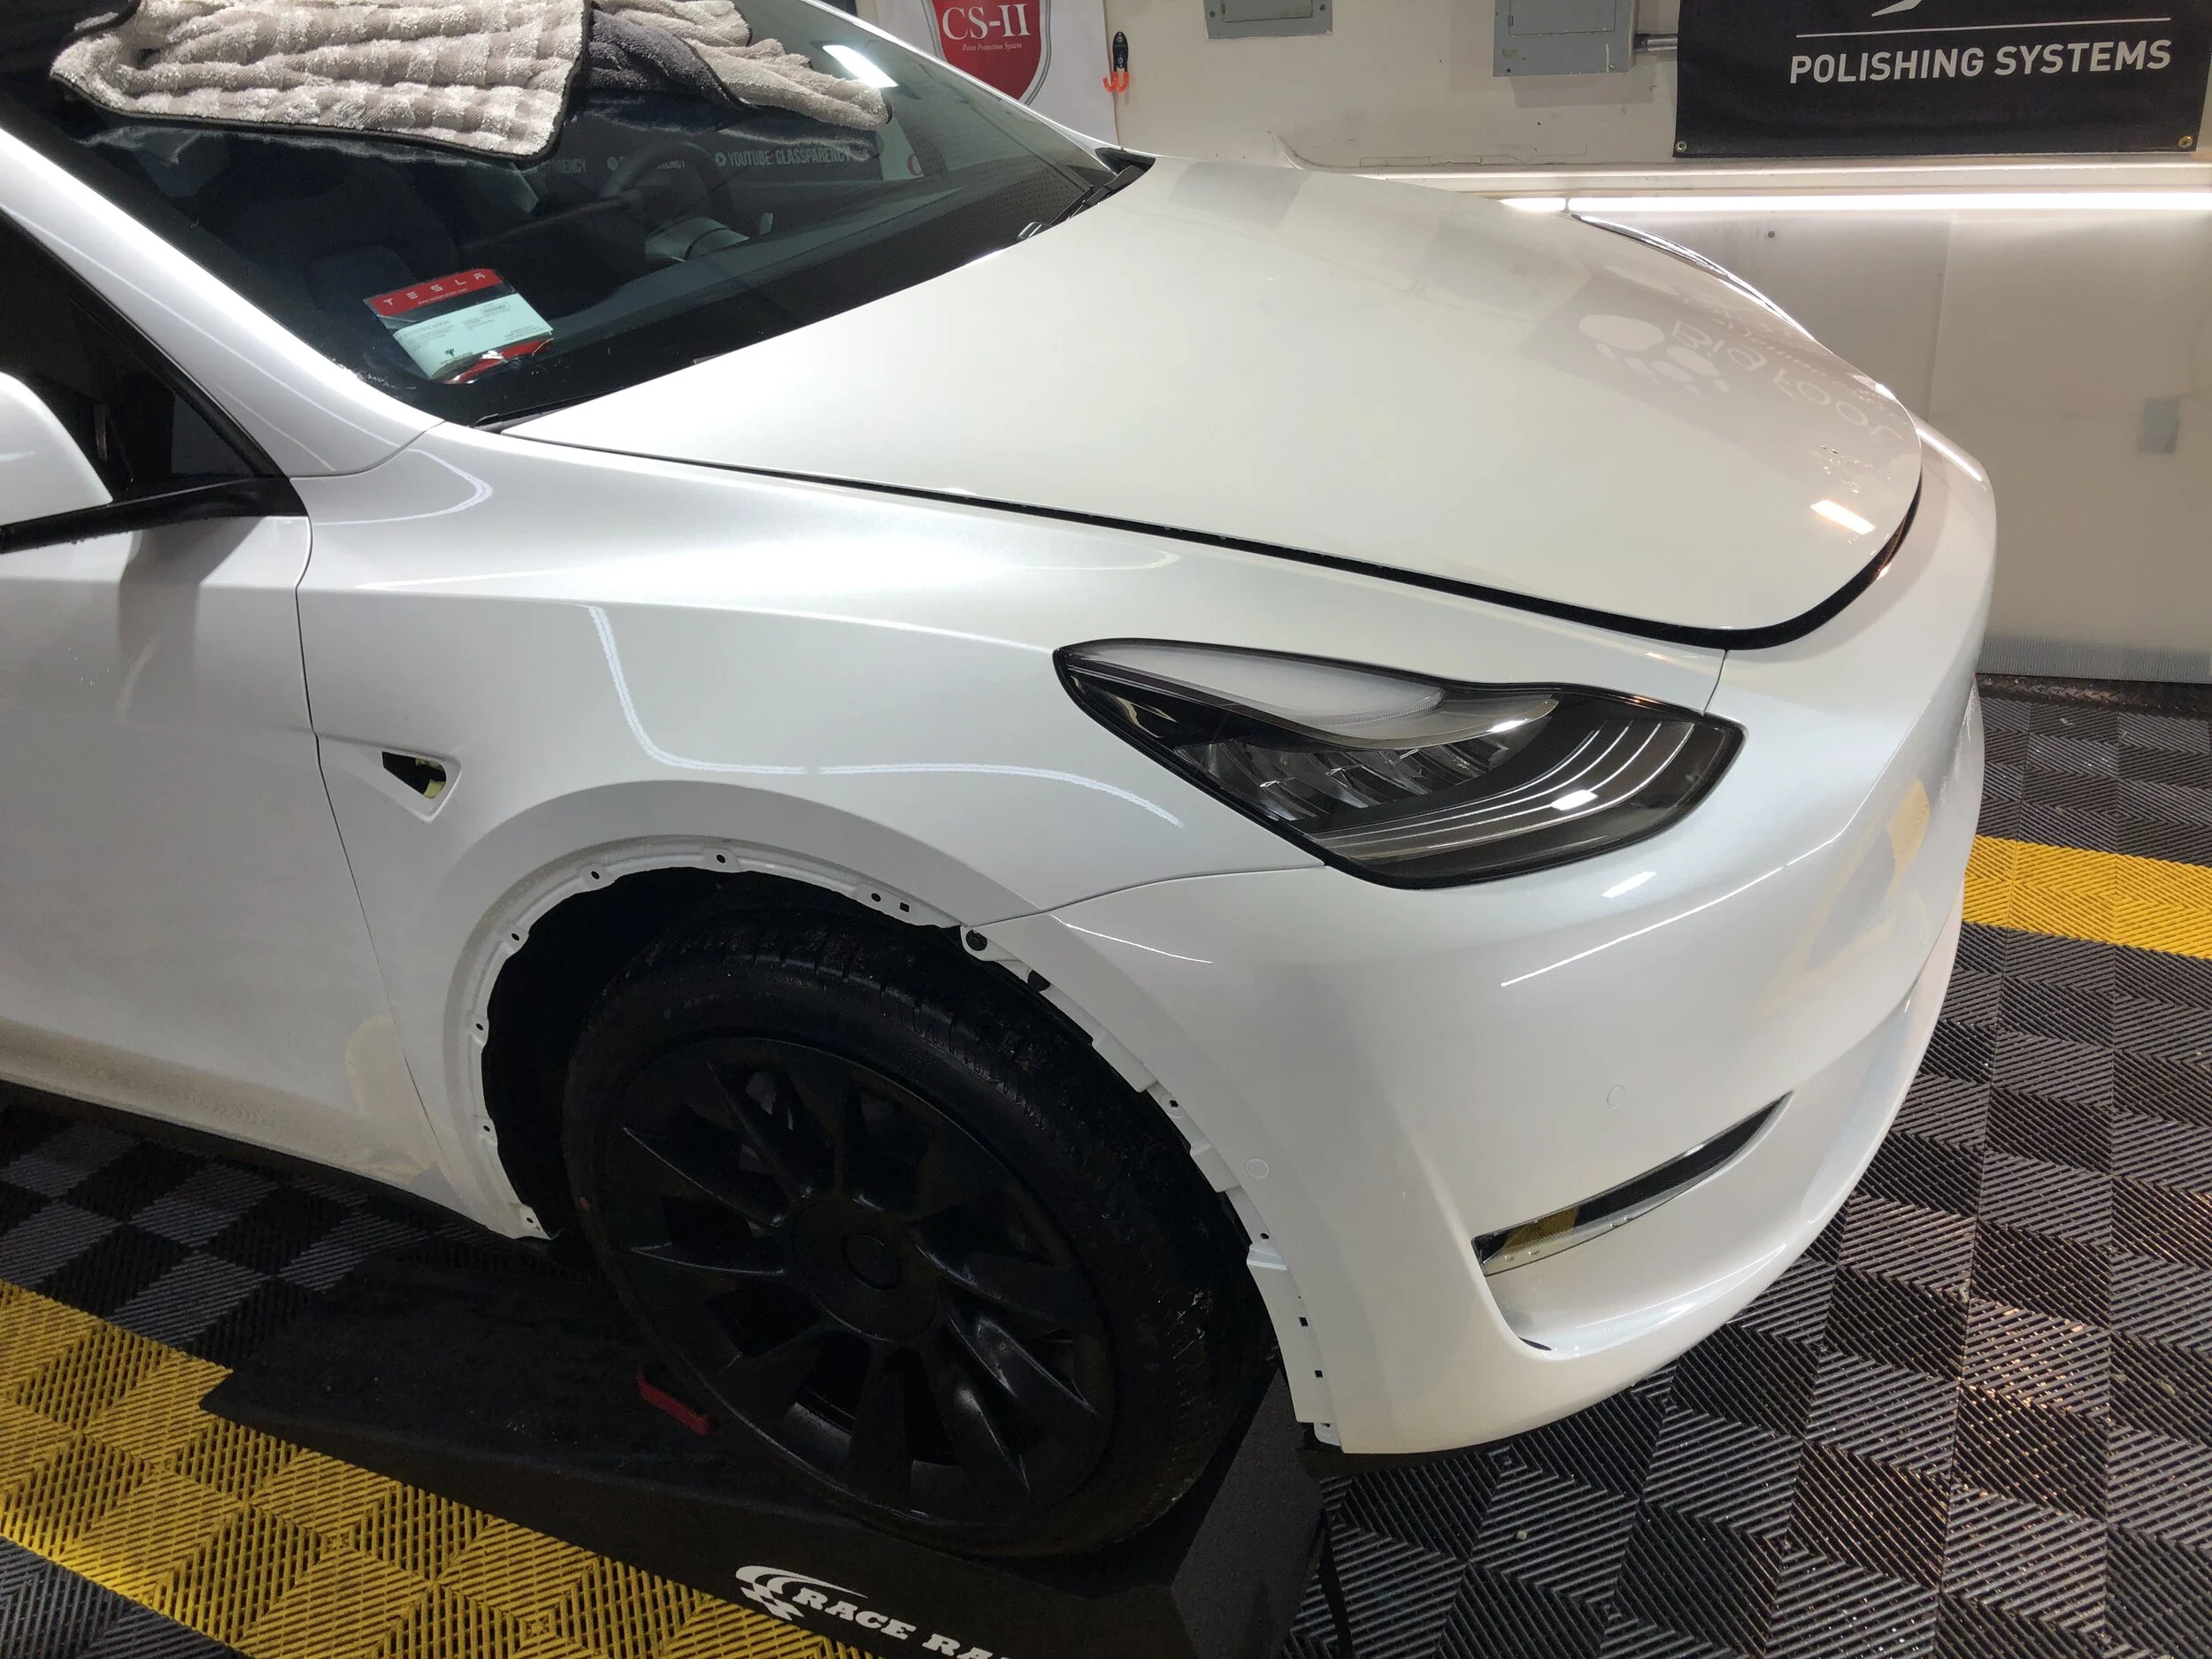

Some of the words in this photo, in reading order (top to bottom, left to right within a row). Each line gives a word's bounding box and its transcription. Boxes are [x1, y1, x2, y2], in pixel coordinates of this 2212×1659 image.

[942, 4, 1032, 41] CS-II
[1789, 47, 1985, 84] POLISHING
[1993, 39, 2173, 76] SYSTEMS
[383, 272, 486, 306] TESLA
[792, 1587, 917, 1640] RACE
[922, 1632, 1012, 1659] RA
